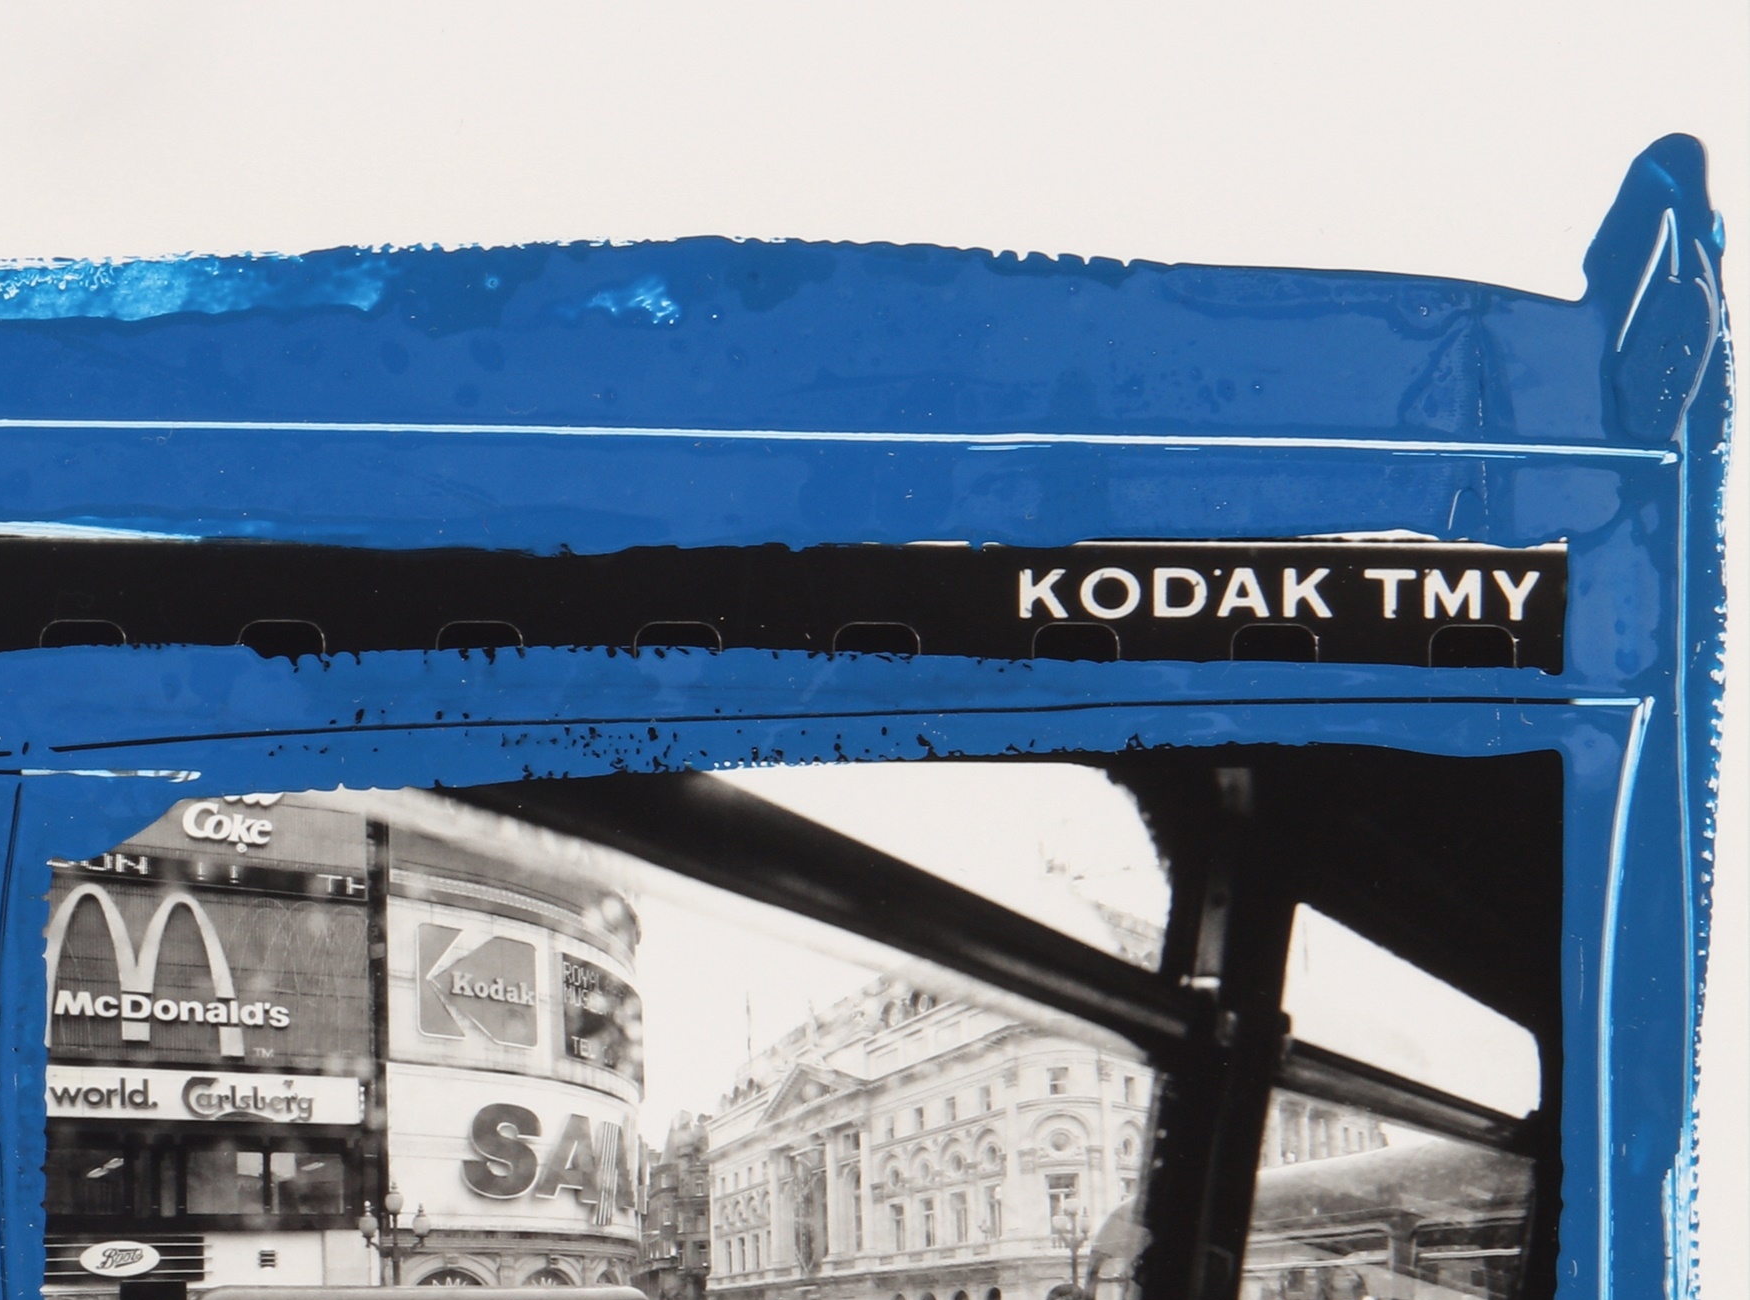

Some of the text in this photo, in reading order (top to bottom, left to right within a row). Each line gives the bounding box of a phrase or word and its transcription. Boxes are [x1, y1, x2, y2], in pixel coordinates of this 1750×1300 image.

[1018, 566, 1541, 621] KODAK TMY
[182, 801, 273, 845] Coke
[53, 989, 291, 1028] McDonald's
[451, 970, 536, 1006] Kodak
[49, 1077, 159, 1110] world.
[181, 1076, 315, 1122] Carlsberg
